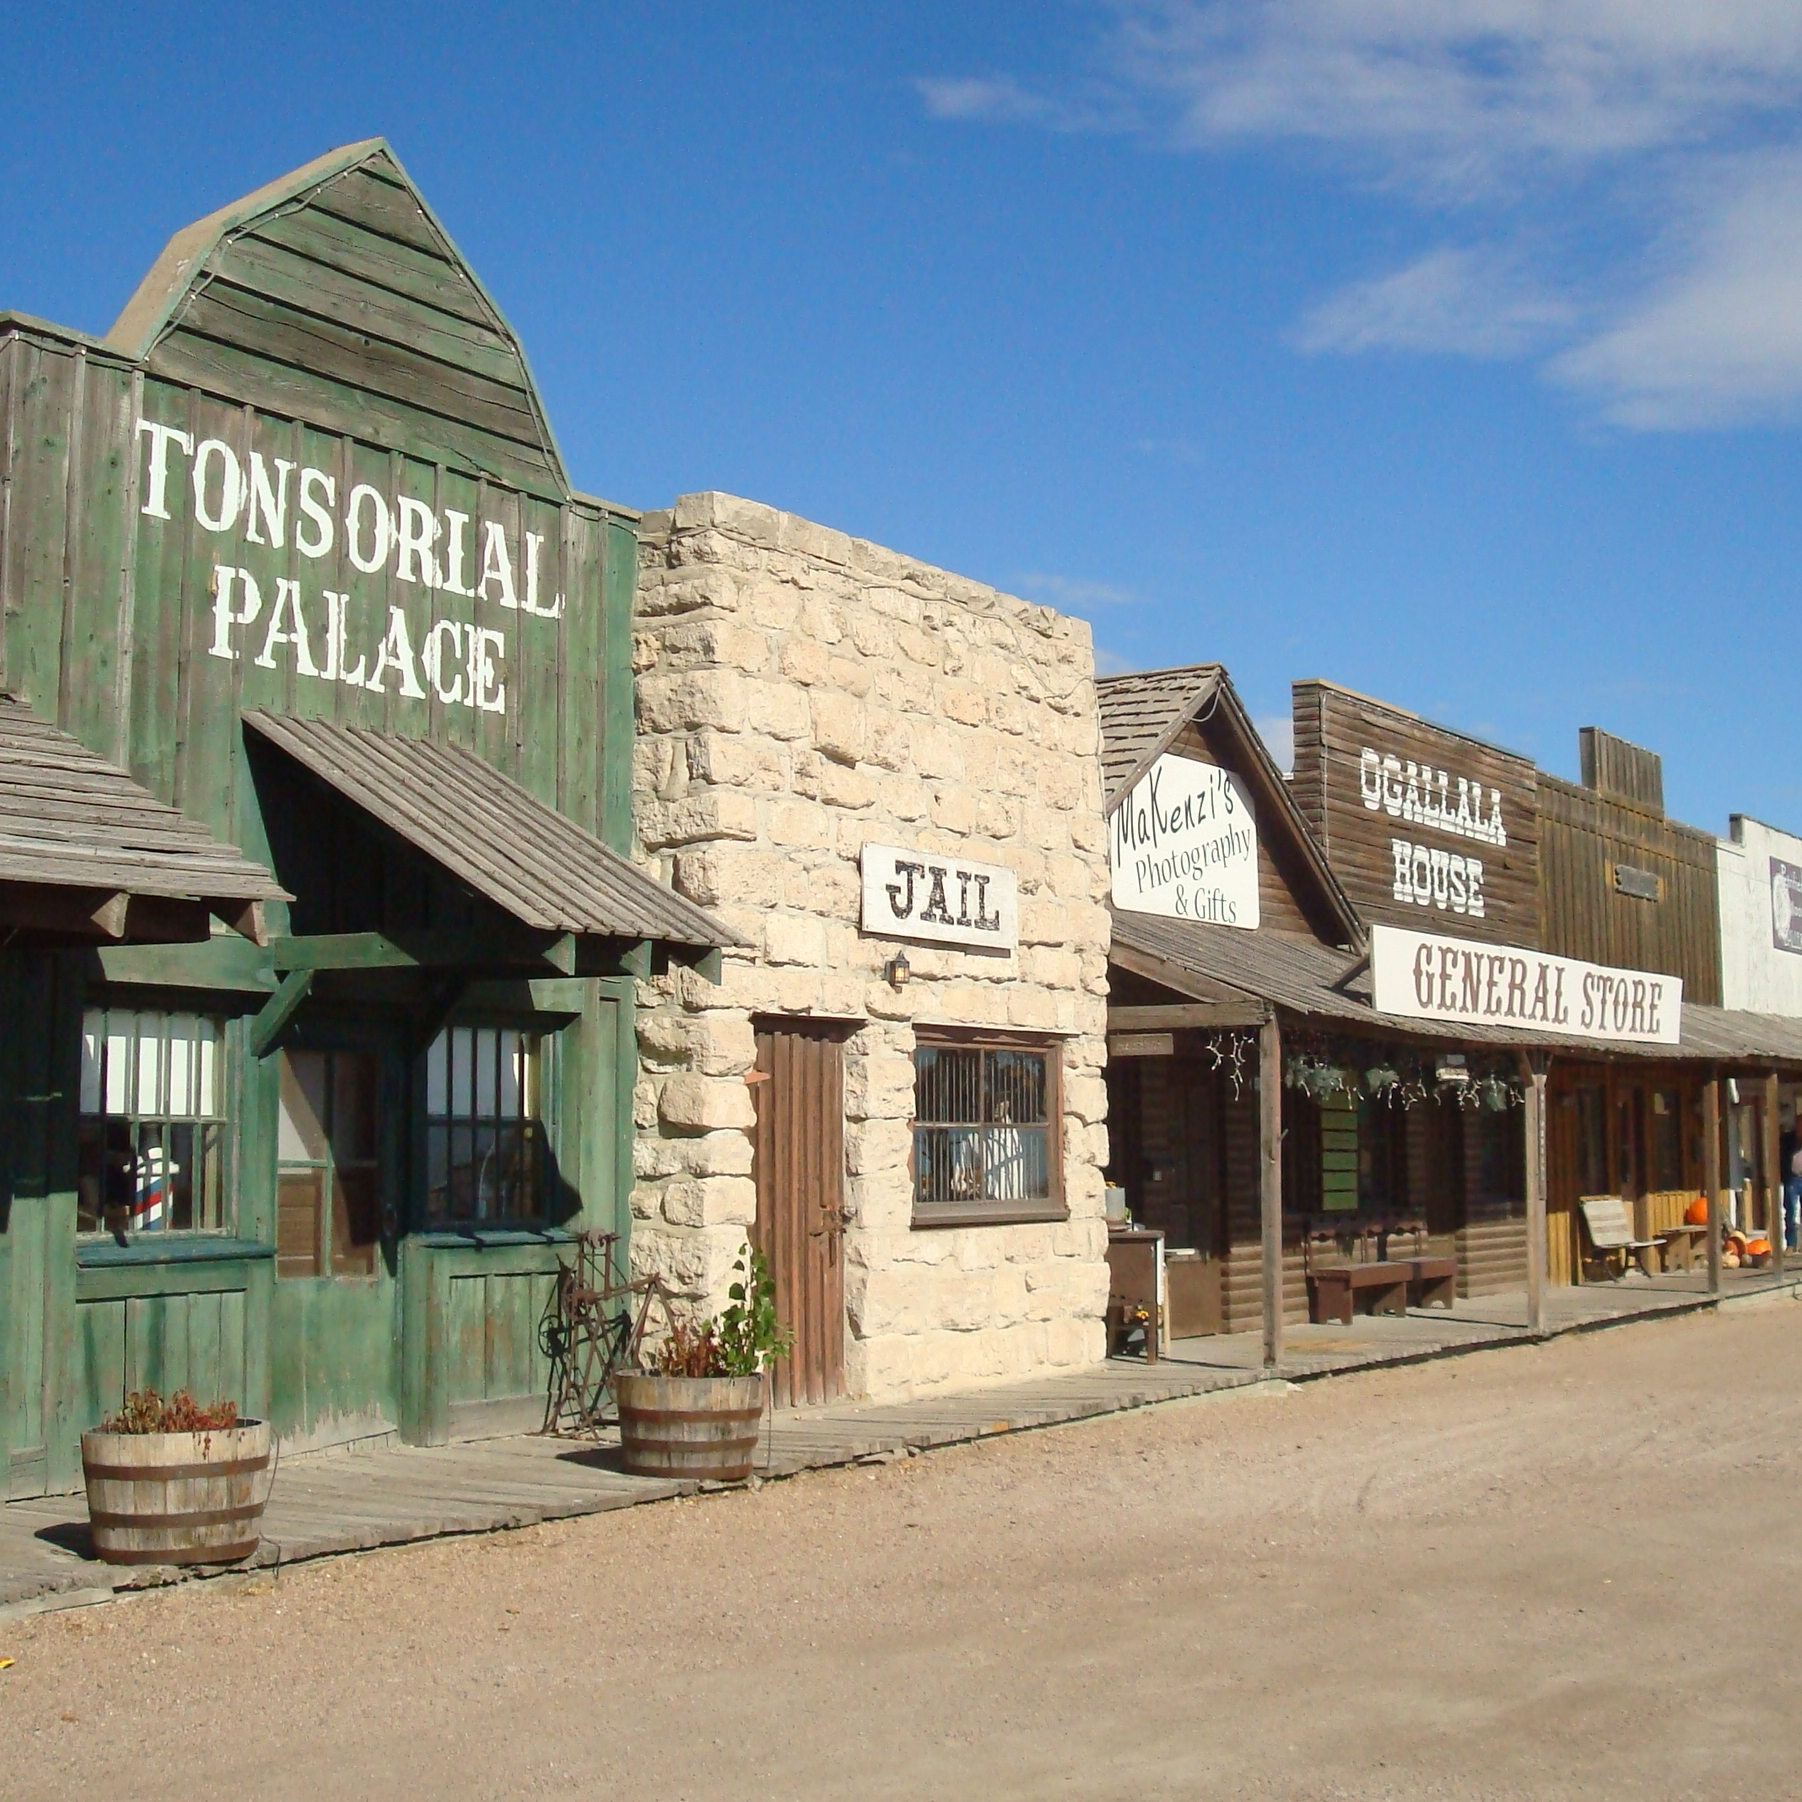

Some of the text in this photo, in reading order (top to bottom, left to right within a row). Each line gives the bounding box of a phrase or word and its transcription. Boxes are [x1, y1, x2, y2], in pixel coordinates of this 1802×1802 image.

[135, 418, 566, 620] TONSORIAL
[208, 565, 506, 715] PALACE
[1361, 747, 1507, 847] OGALLALA
[885, 860, 1001, 932] JAIL
[1135, 823, 1251, 894] Photography
[1391, 838, 1486, 918] HOUSE
[1175, 884, 1237, 924] & Gifts
[1412, 942, 1663, 1035] GENERAL STORE
